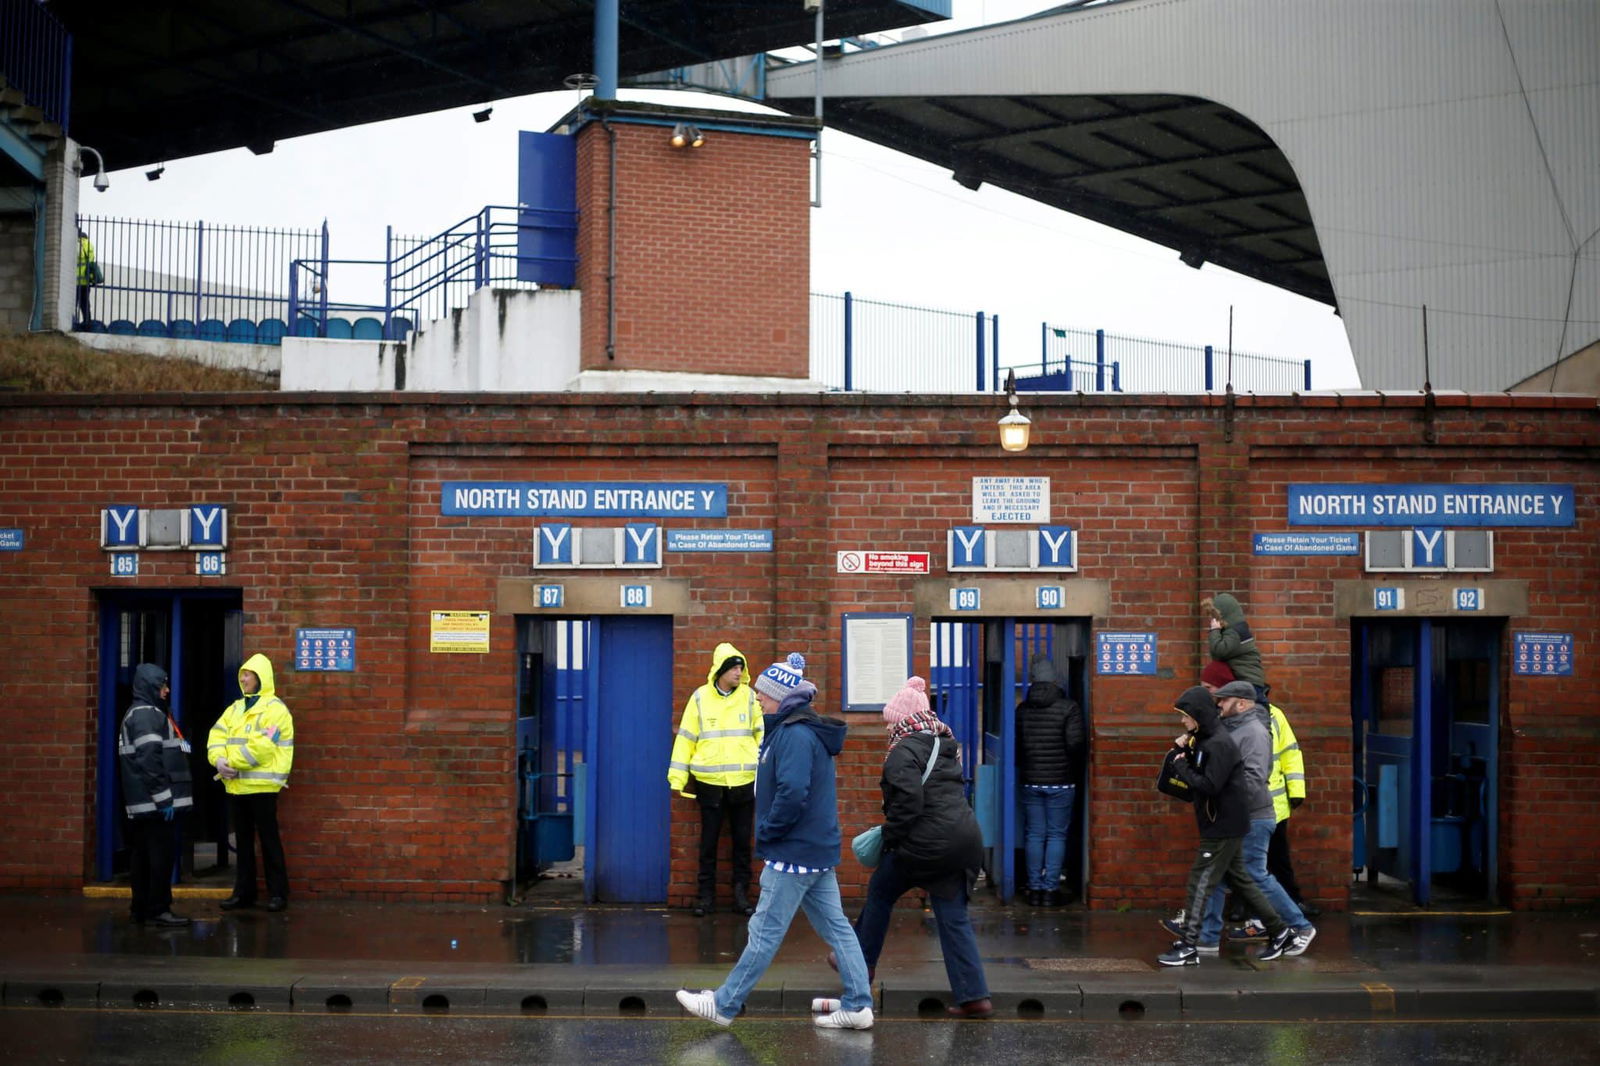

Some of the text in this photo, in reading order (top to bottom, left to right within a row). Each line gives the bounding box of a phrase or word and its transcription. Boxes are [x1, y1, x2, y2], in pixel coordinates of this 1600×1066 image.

[456, 489, 715, 510] NORTH STAND ENTRANCE Y
[1300, 495, 1563, 515] NORTH STAND ENTRANCE Y
[109, 509, 135, 541] Y
[193, 508, 220, 540] Y
[542, 527, 568, 560] Y
[627, 527, 654, 560] Y
[955, 529, 982, 562] Y
[1040, 530, 1068, 562] Y
[1415, 530, 1442, 562] Y
[118, 557, 133, 572] 85
[203, 556, 218, 571] 86
[869, 561, 893, 569] beyond
[544, 589, 559, 604] 87
[627, 588, 643, 604] 88
[959, 591, 975, 607] 89
[1042, 590, 1057, 605] 90
[1378, 591, 1392, 606] 91
[1460, 591, 1475, 607] 92
